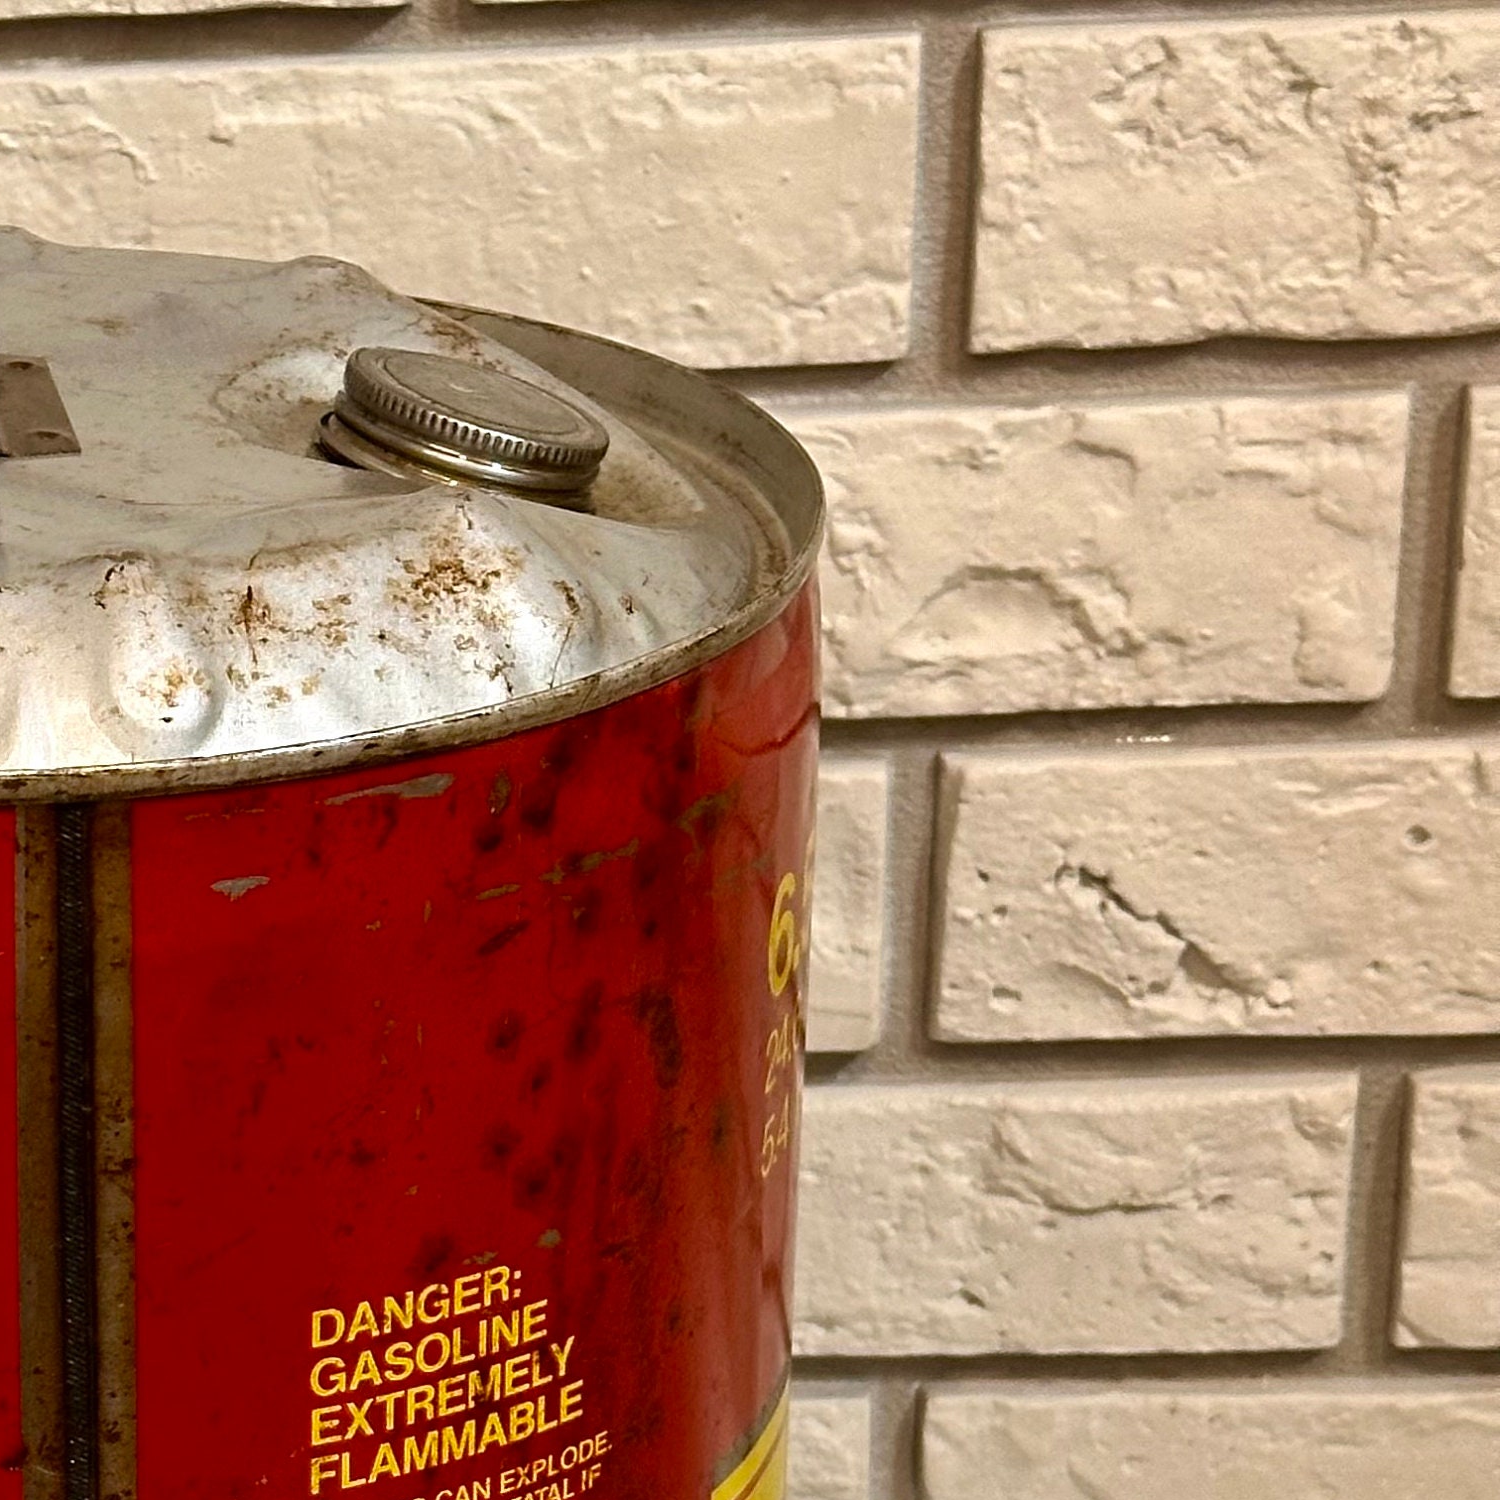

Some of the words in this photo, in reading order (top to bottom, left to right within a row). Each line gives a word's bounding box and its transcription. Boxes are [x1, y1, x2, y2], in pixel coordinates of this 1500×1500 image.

[309, 1300, 549, 1396] GASOLINE
[311, 1266, 522, 1347] DANGER:
[310, 1338, 576, 1445] EXTREMELY
[309, 1382, 584, 1493] FLAMMABLE
[499, 1430, 613, 1494] EXPLODE.
[580, 1462, 602, 1492] IF
